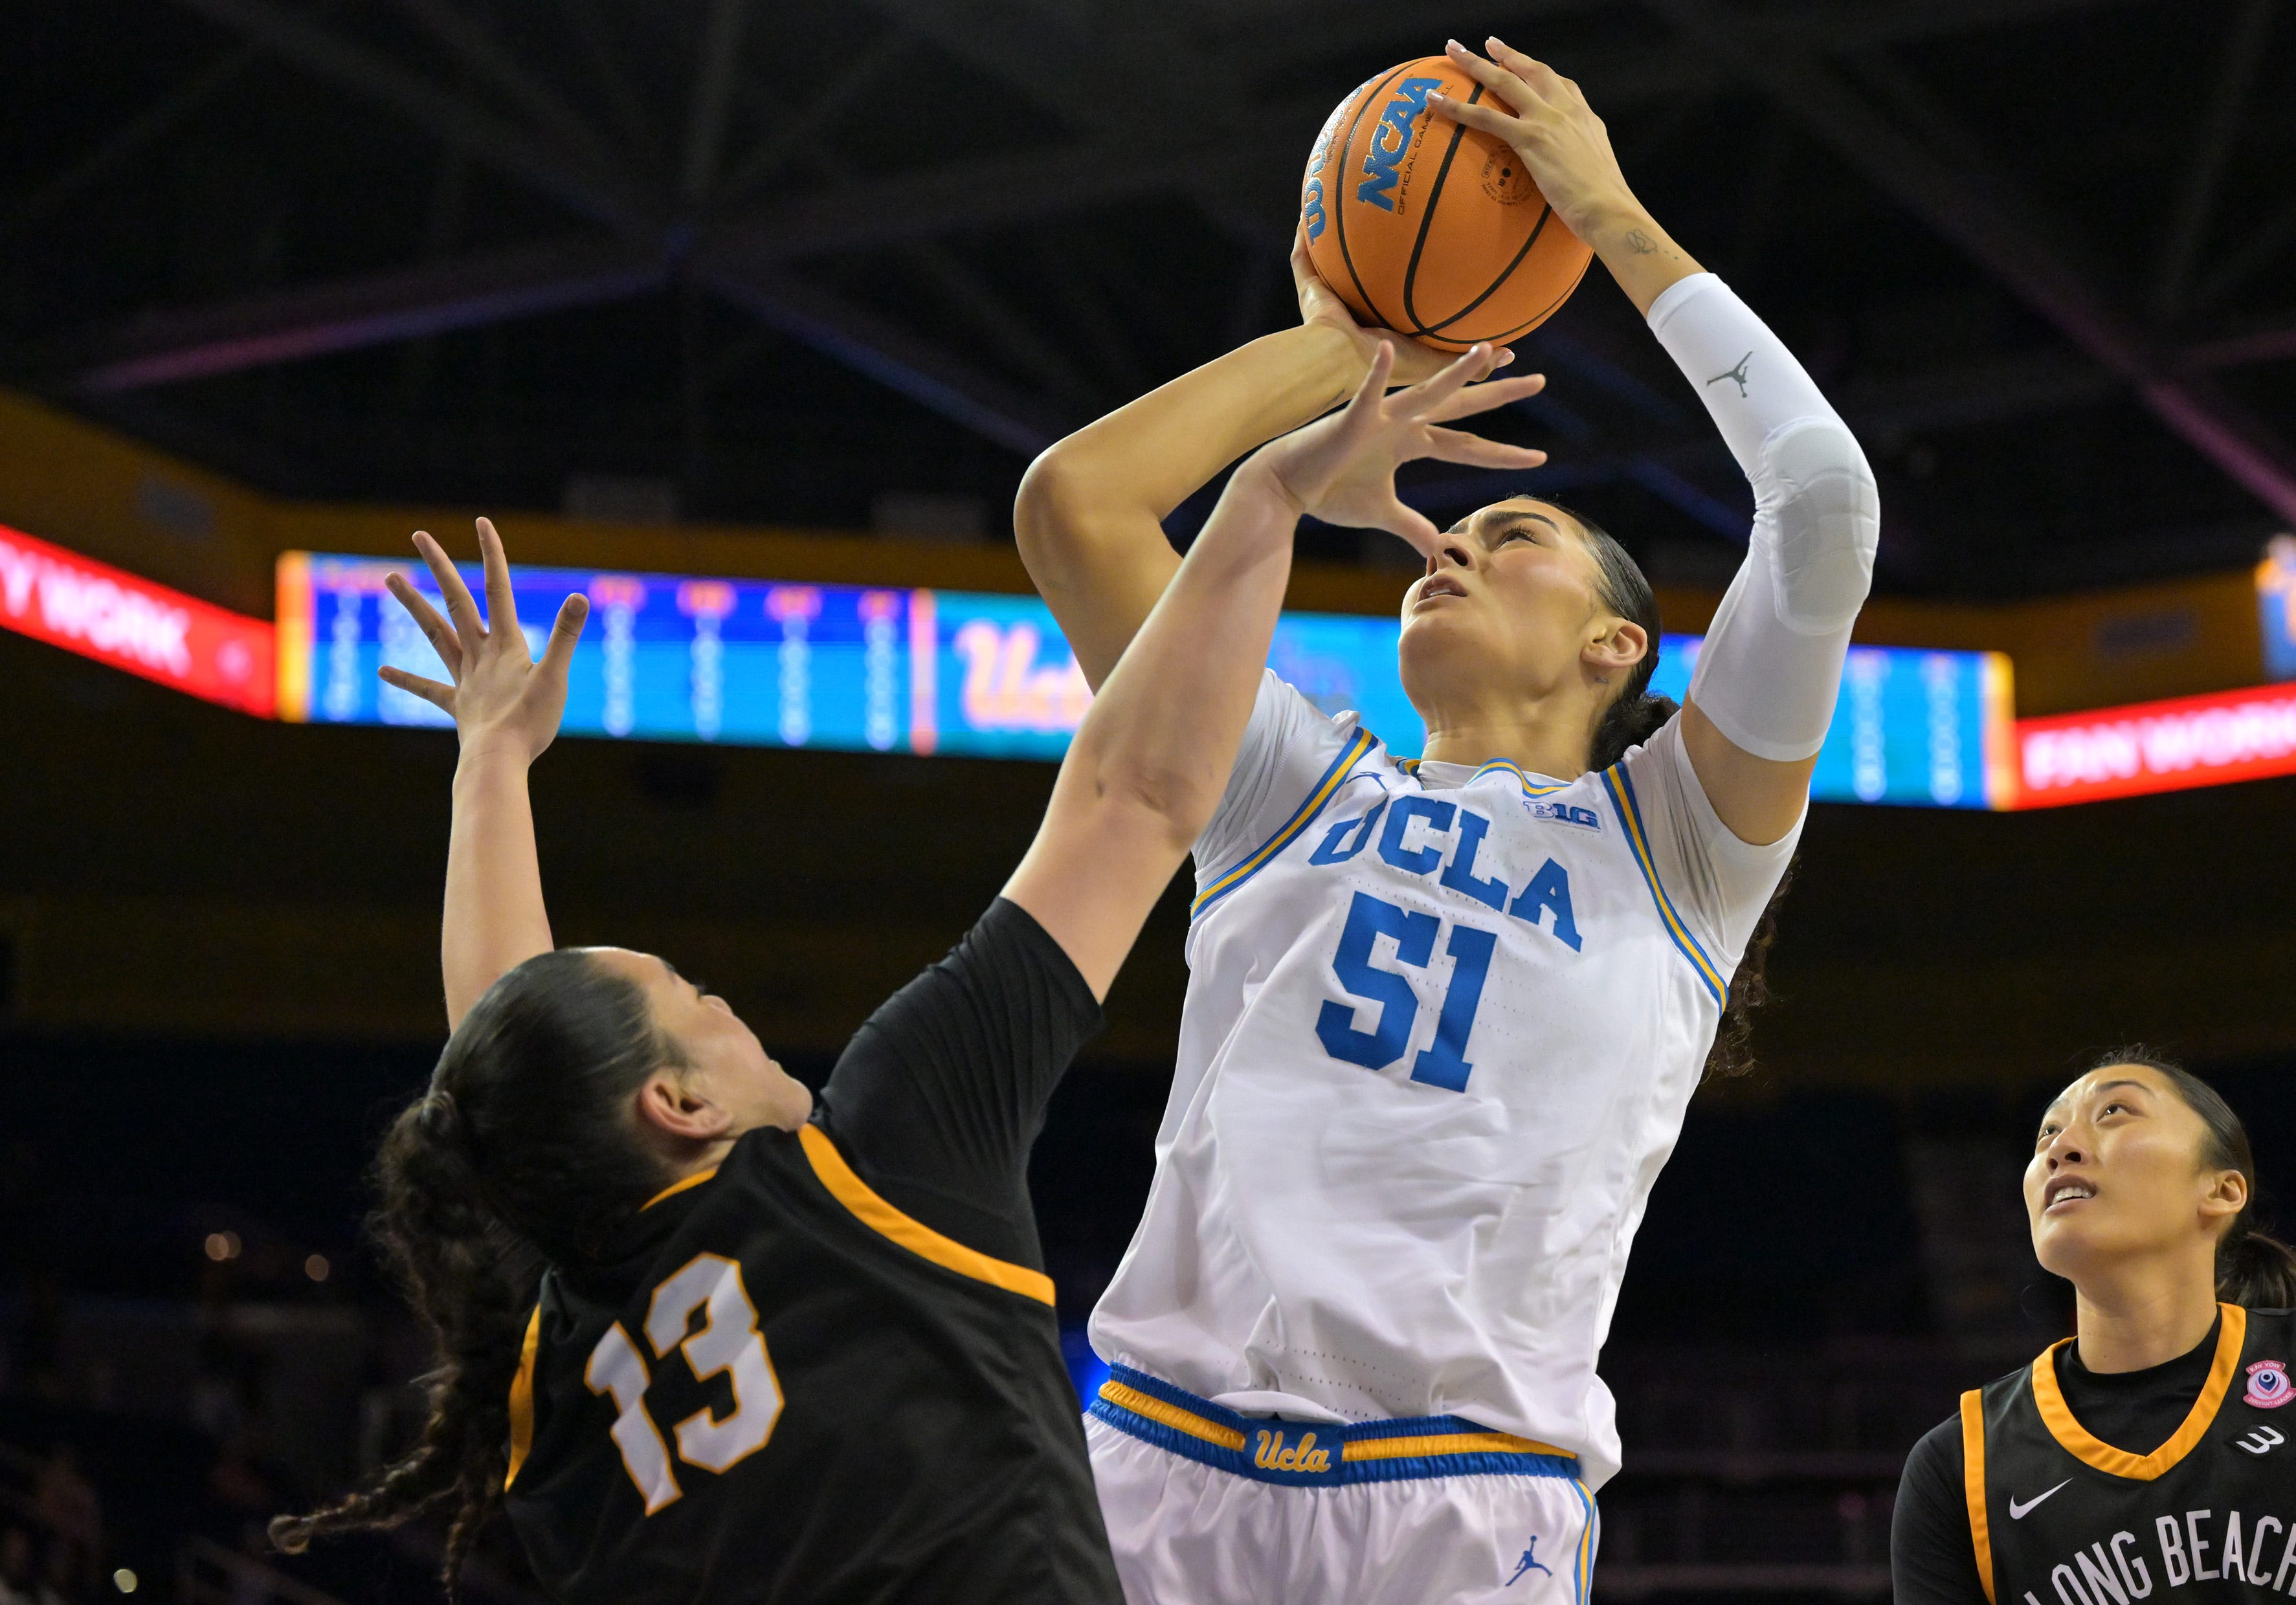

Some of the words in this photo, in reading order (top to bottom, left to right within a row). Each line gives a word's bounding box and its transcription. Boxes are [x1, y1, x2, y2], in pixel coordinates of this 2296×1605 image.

[1357, 77, 1443, 212] NCAA
[1398, 152, 1418, 216] OFFICIAL
[1414, 112, 1434, 148] GAME
[1308, 795, 1583, 953] UCLA
[1315, 891, 1497, 1093] 51
[584, 1252, 785, 1517] 13
[1254, 1430, 1331, 1473] Ucla
[2023, 1531, 2153, 1605] ONG
[2156, 1509, 2296, 1597] BEACH
